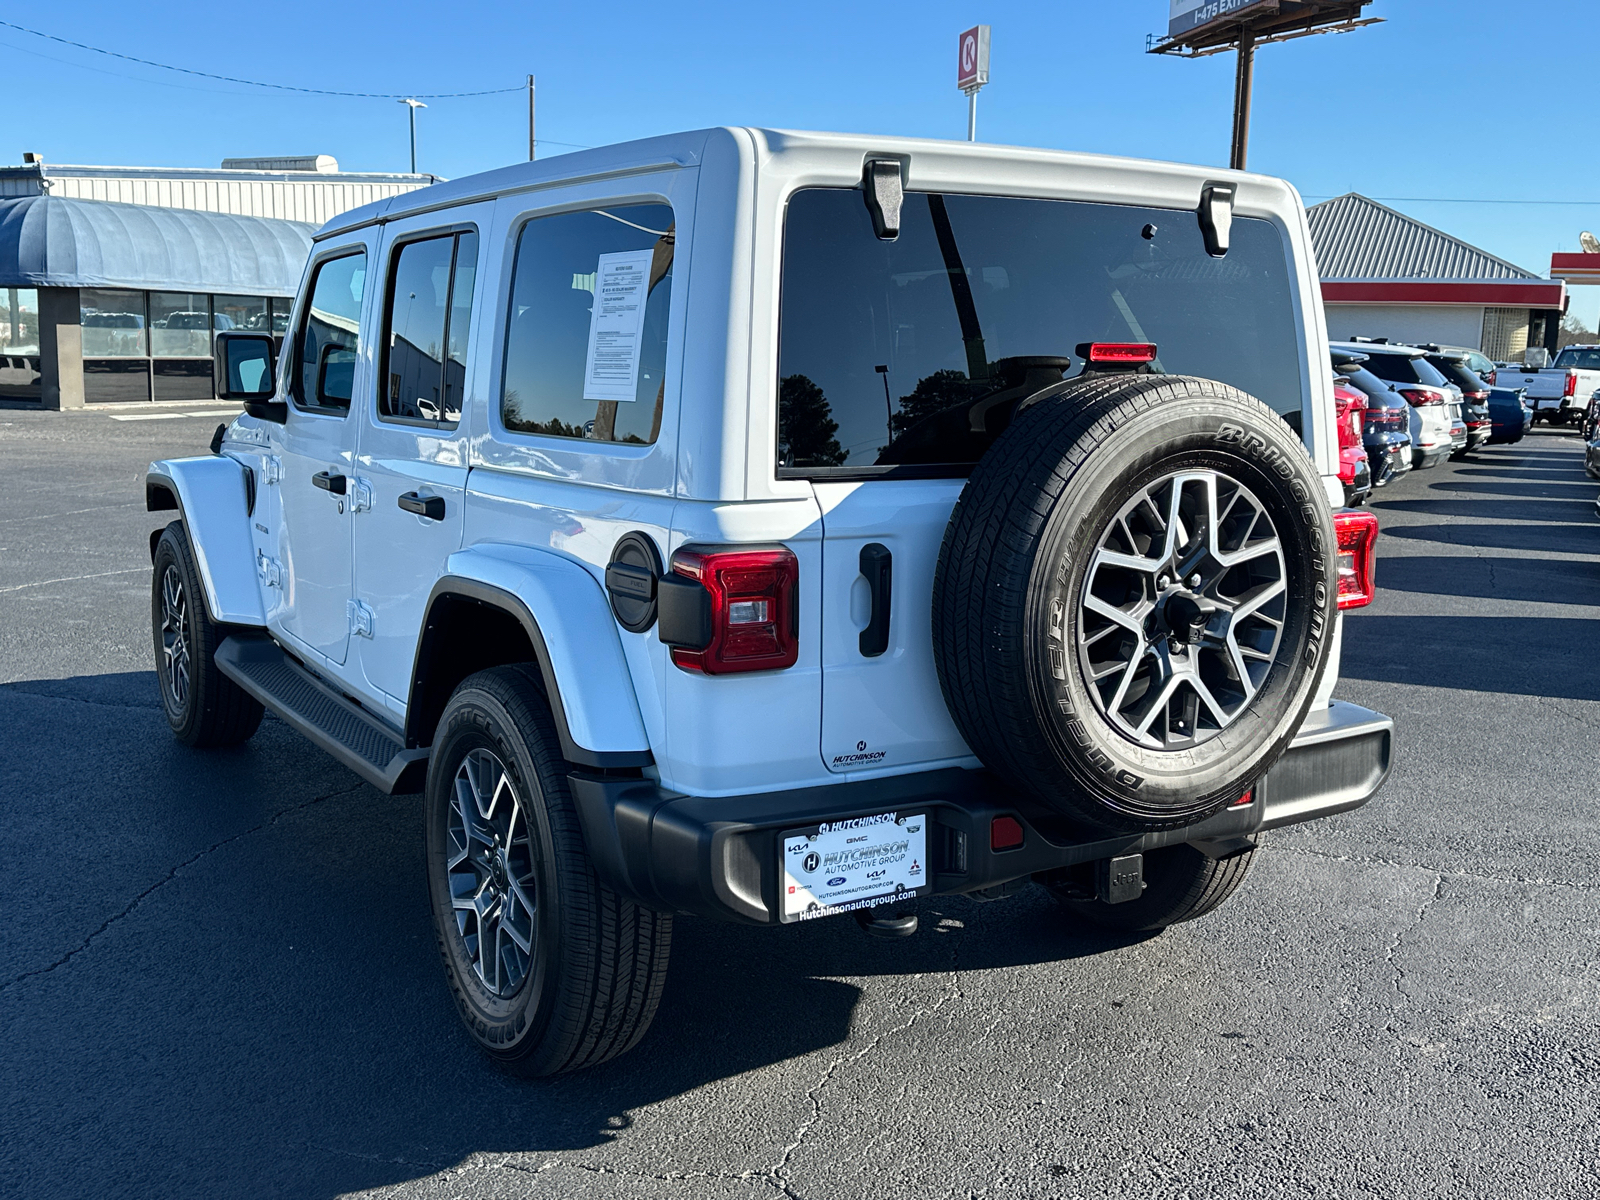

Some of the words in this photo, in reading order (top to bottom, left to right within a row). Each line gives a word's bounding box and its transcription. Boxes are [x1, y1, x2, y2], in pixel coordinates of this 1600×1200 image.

[1194, 2, 1218, 24] I-475
[1213, 422, 1328, 671] BRIDGESTONE
[630, 580, 645, 589] FUEL
[1047, 596, 1145, 791] DUELER
[833, 751, 886, 763] HUTCHINSON
[833, 760, 864, 768] AUTOMOTIVE
[830, 812, 897, 832] HUTCHINSON
[846, 835, 868, 844] GMC
[823, 840, 909, 867] HUTCHINSON
[824, 858, 877, 875] AUTOMOTIVE
[879, 853, 906, 865] GROUP
[1112, 872, 1139, 886] Jeep
[818, 880, 894, 899] HUTCHINSONAUTOGROUP.COM
[800, 890, 917, 921] Hutchinsonautogroup.com
